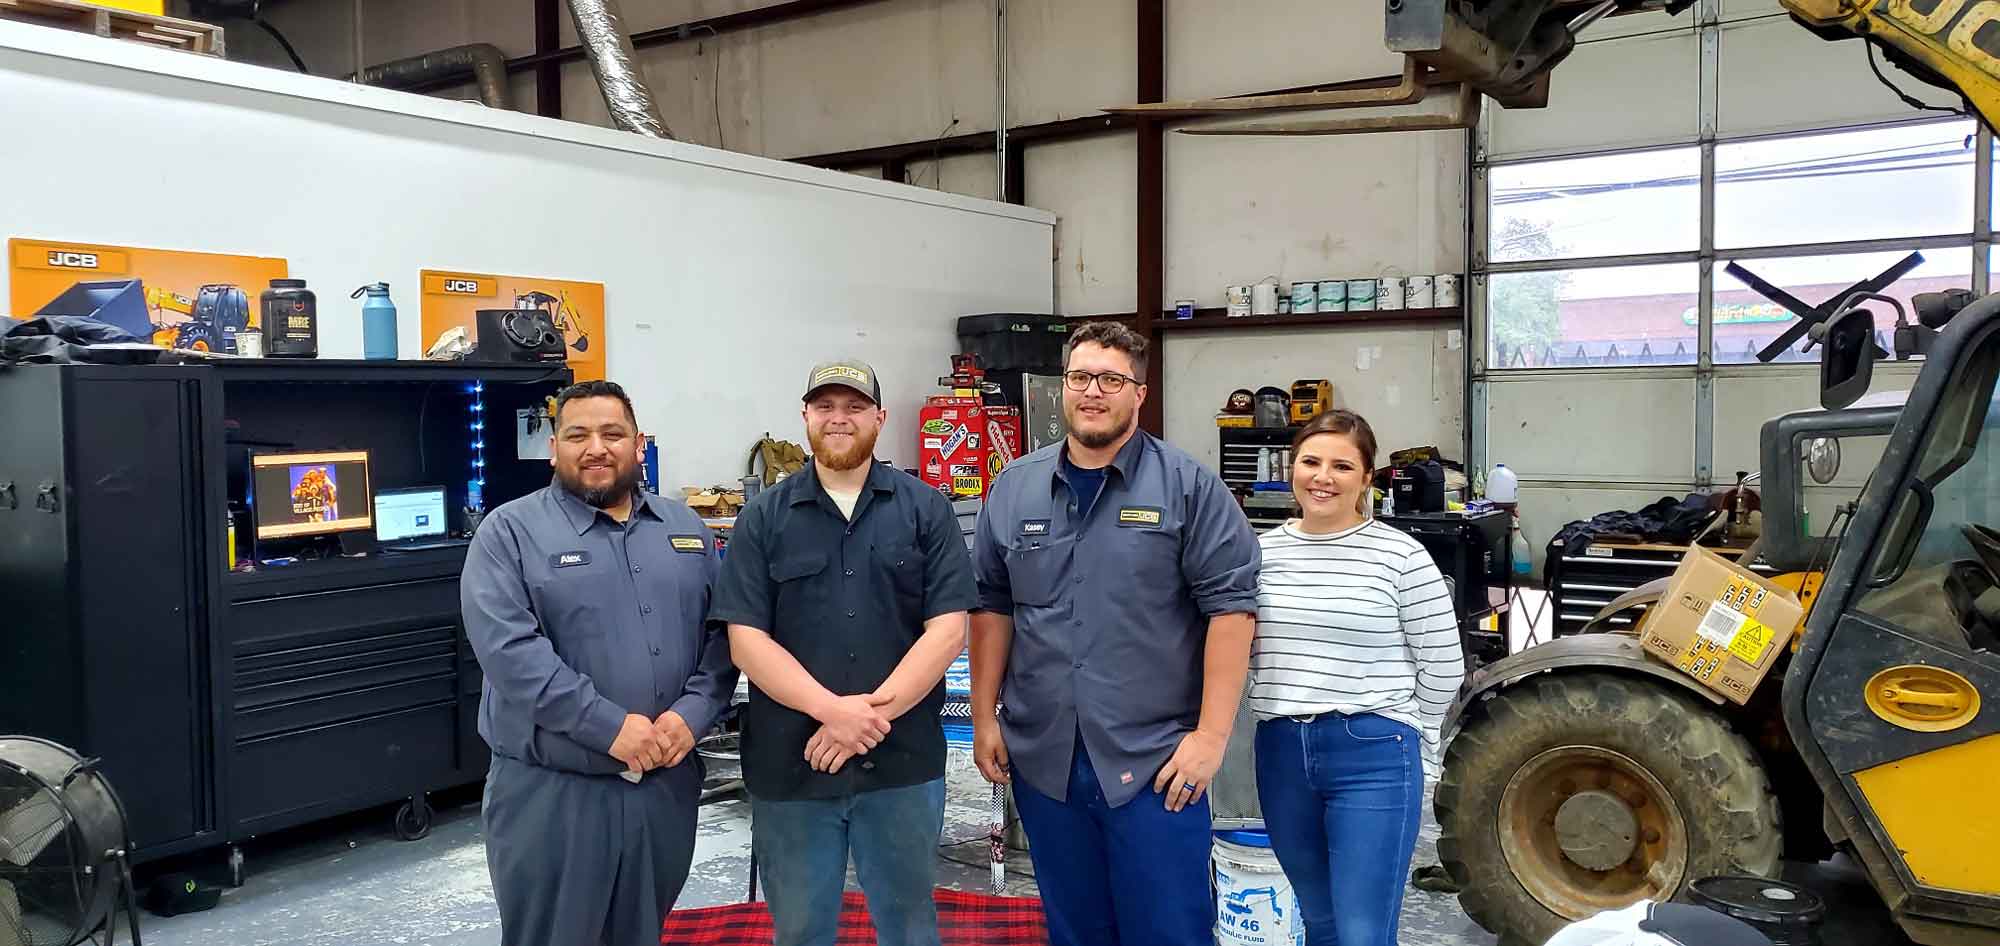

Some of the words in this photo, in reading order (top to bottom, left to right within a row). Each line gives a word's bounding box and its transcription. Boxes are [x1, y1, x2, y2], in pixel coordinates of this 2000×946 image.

[48, 251, 98, 268] JCB
[445, 280, 478, 293] JCB
[941, 426, 966, 455] HOGAN'S
[955, 478, 981, 489] BRODIX
[1024, 523, 1045, 532] Kasey
[560, 554, 582, 564] Alex
[1652, 637, 1679, 655] JCB
[1722, 676, 1750, 694] JCB
[1219, 910, 1237, 927] AW
[1240, 918, 1260, 932] 46
[1243, 934, 1265, 943] FLUID
